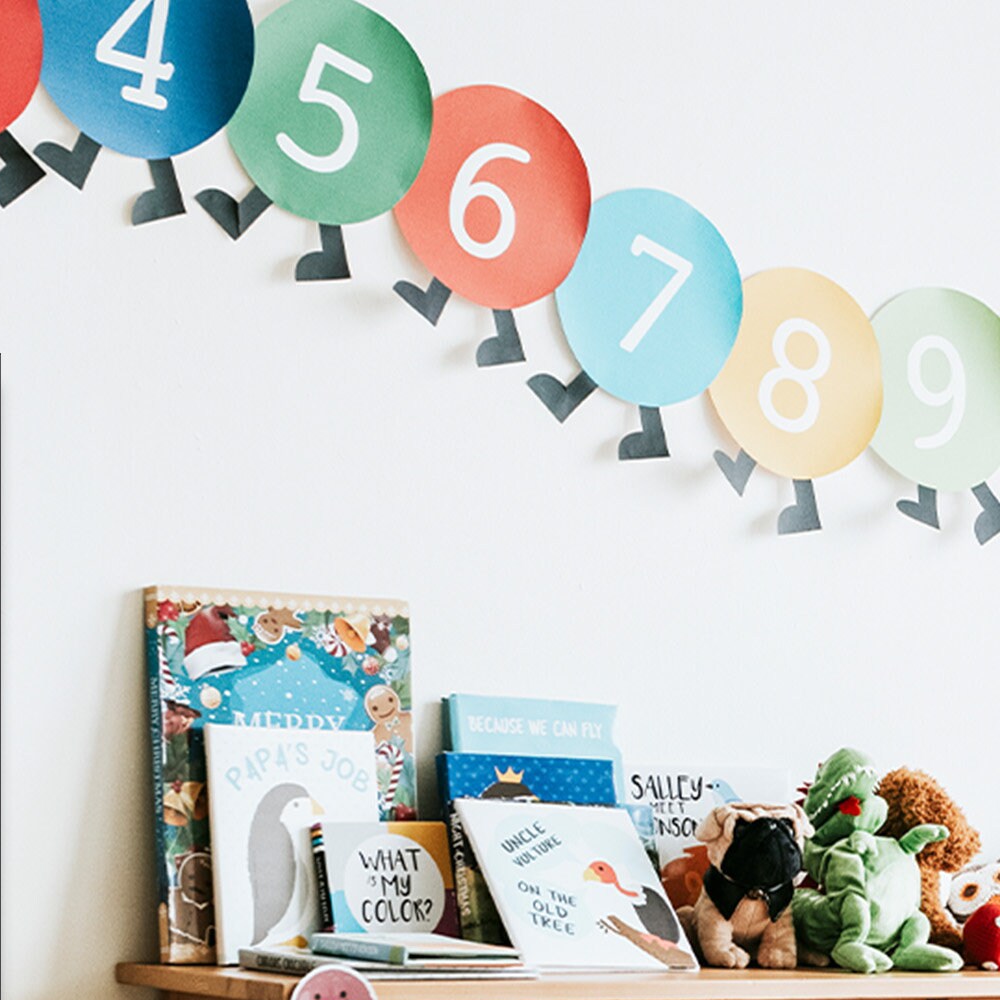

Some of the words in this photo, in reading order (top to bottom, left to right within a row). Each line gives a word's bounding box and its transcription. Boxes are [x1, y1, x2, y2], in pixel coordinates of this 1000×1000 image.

[95, 0, 175, 111] 4
[276, 42, 373, 173] 5
[449, 142, 532, 260] 6
[619, 233, 694, 353] 7
[758, 317, 832, 434] 8
[907, 334, 967, 450] 9
[468, 715, 524, 735] BECAUSE
[528, 720, 548, 736] WE
[553, 720, 578, 738] CAN
[581, 722, 603, 740] FLY
[224, 742, 309, 791] PAPA'S
[321, 750, 370, 793] JOB
[631, 774, 703, 801] SALLEY
[501, 820, 547, 854] UNCLE
[512, 834, 562, 868] VULTURE
[358, 849, 421, 872] WHAT
[362, 899, 433, 923] COLOR?
[518, 880, 540, 897] ON
[550, 888, 577, 908] THE
[532, 900, 568, 919] OLD
[528, 911, 575, 936] TREE
